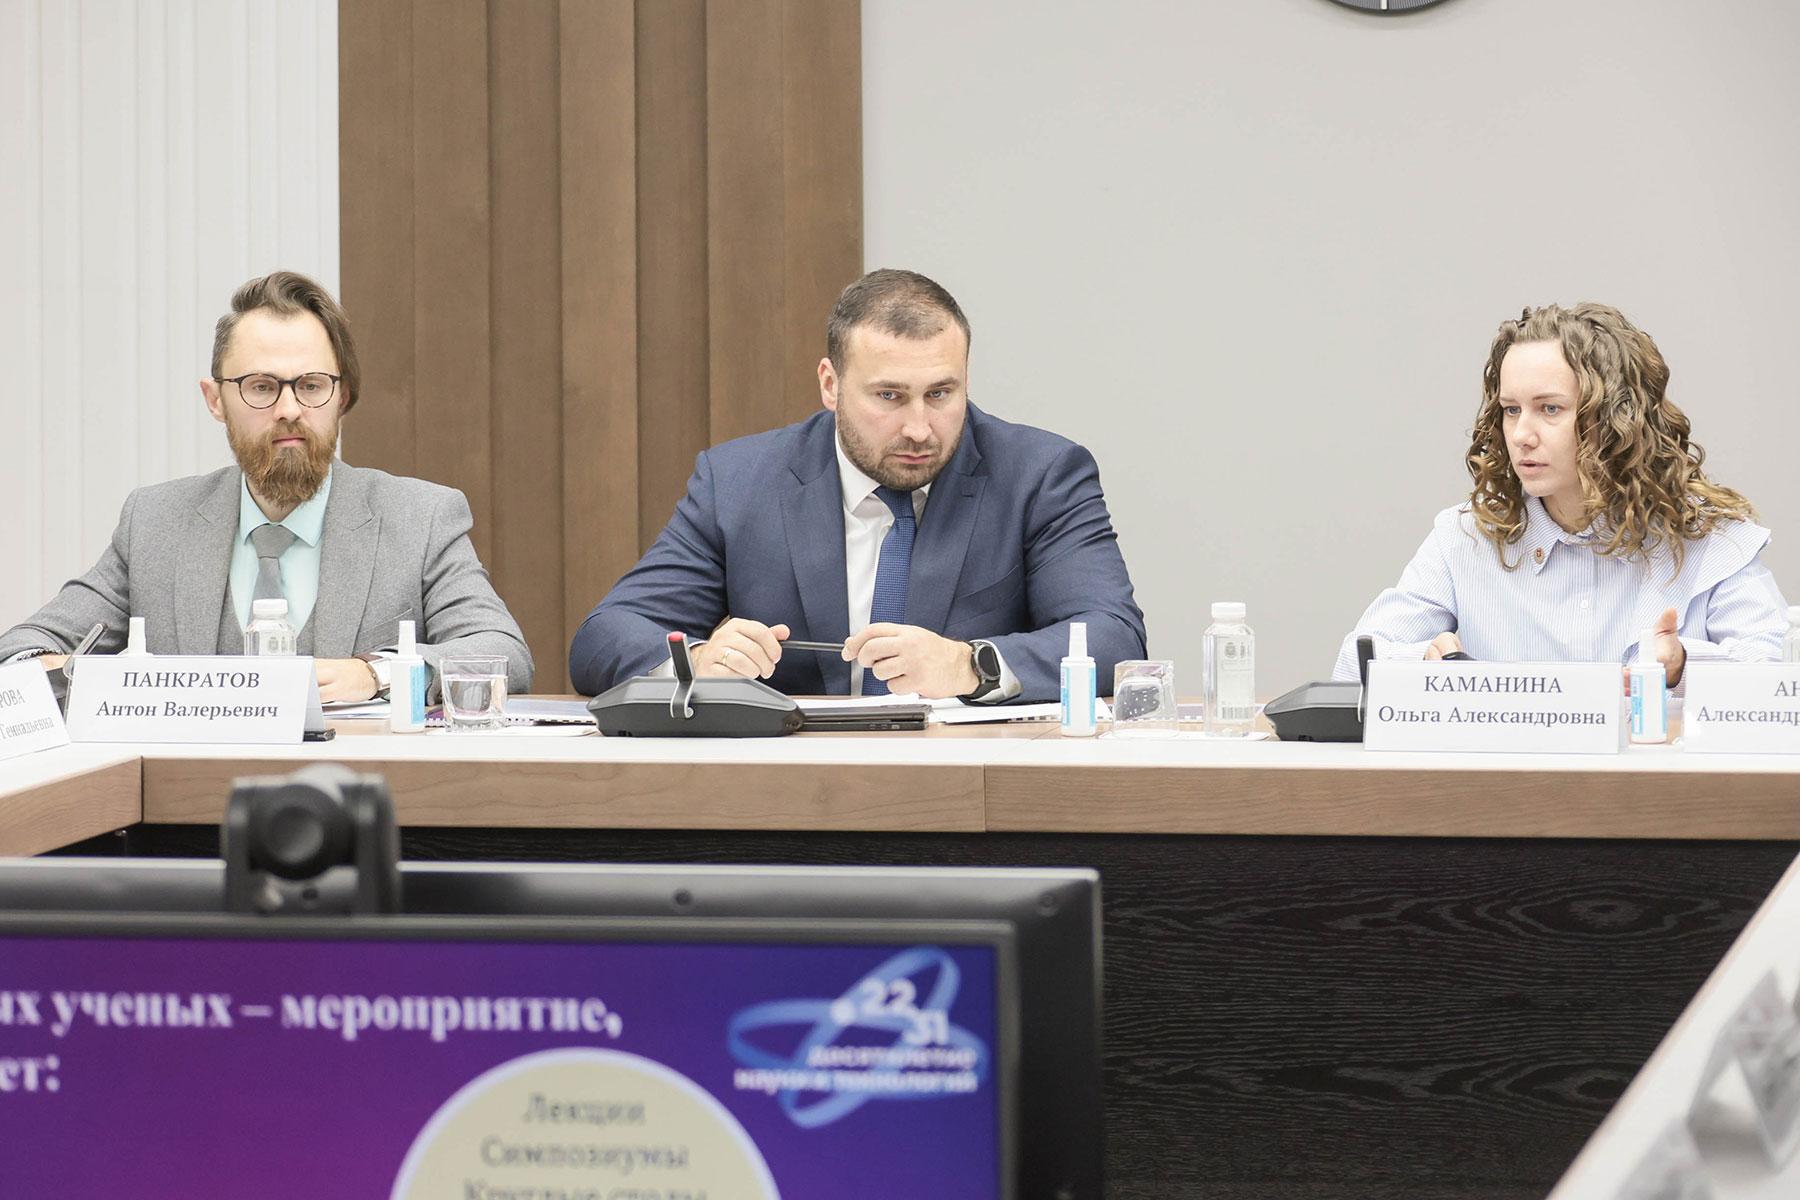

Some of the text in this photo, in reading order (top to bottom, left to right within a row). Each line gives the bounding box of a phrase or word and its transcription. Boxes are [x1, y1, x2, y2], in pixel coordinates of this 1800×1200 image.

[122, 671, 260, 688] ПАНКРАТОВ
[1424, 675, 1563, 694] КАМАНИНА
[96, 700, 279, 721] Антон Валерьевич
[1378, 705, 1606, 728] Ольга Александровна
[51, 991, 233, 1037] ученых
[281, 994, 623, 1042] мероприятие,
